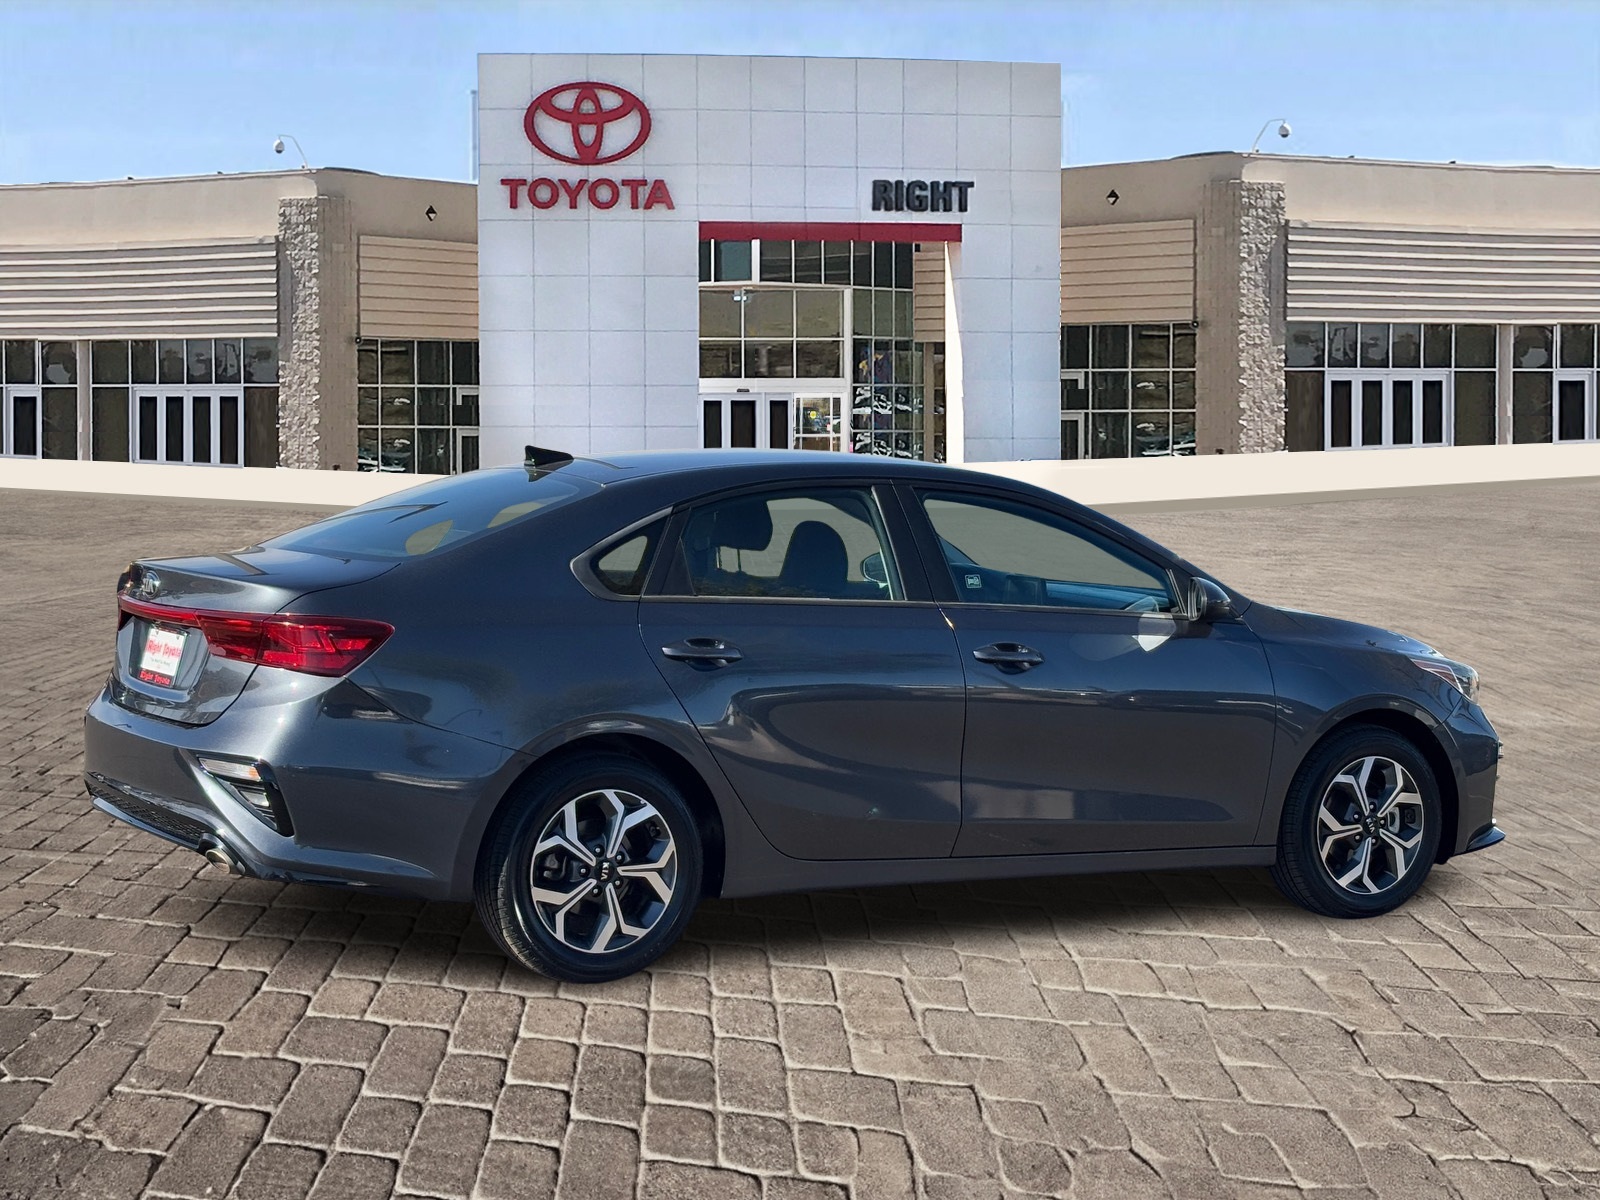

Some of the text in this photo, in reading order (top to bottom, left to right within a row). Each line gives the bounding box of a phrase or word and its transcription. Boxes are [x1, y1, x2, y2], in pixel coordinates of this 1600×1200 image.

[500, 177, 675, 210] TOYOTA
[872, 179, 975, 212] RIGHT
[147, 640, 181, 657] Right Toyota
[140, 670, 170, 685] Right Toyota
[600, 862, 610, 881] KIA
